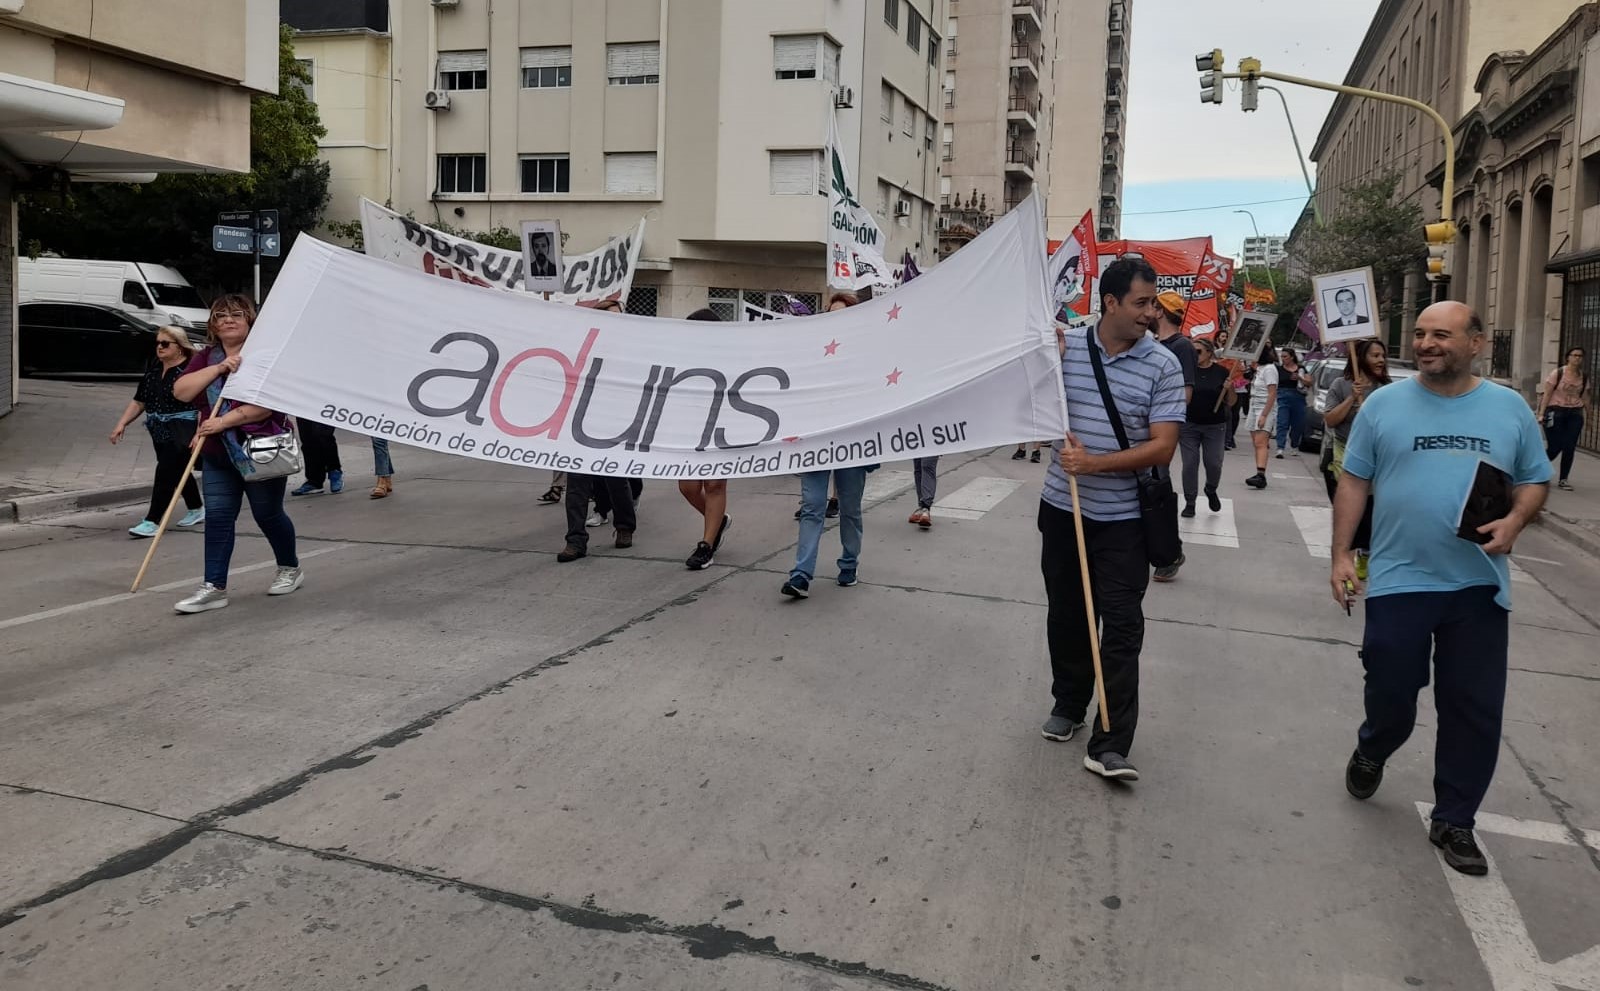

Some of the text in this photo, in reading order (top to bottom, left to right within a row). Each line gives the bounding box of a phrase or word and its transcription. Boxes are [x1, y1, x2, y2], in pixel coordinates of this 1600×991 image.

[216, 241, 222, 249] 0
[1202, 253, 1231, 283] PTS
[1156, 275, 1198, 287] RENTE
[406, 328, 790, 452] aduns
[320, 403, 968, 477] asociación de docentes de la universidad nacional del sur
[1412, 435, 1491, 455] RESISTE
